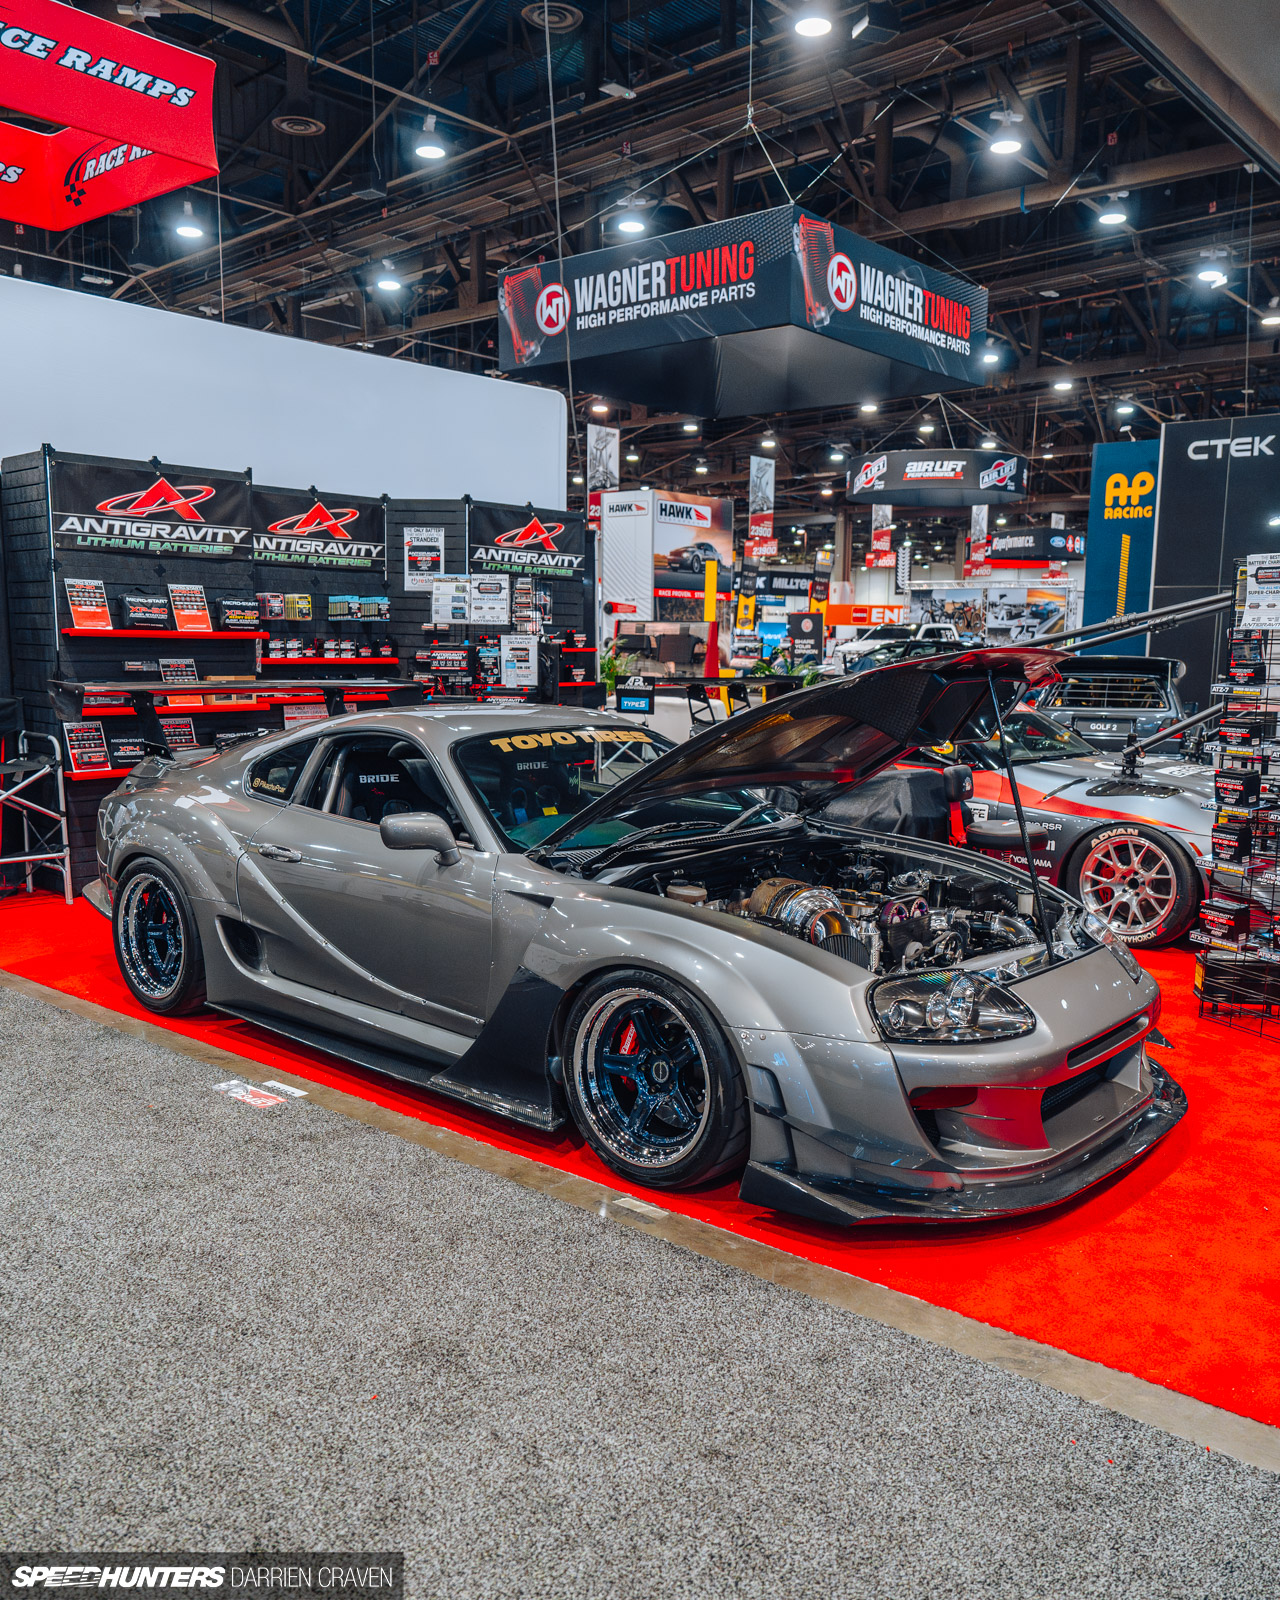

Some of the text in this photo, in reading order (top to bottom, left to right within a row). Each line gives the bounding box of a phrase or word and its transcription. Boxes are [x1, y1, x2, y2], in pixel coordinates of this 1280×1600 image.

[56, 45, 197, 107] RAMPS
[82, 143, 129, 182] RACE
[576, 281, 756, 330] HIGH PERFORMANCE PARTS
[860, 303, 971, 356] HIGH PERFORMANCE PARTS
[1187, 434, 1277, 461] CTEK
[867, 459, 886, 477] LIFT
[982, 473, 999, 485] AIR
[999, 463, 1015, 477] LIFT
[1104, 471, 1155, 507] AP
[609, 503, 633, 513] HAWK
[659, 503, 693, 520] HAWK
[1104, 505, 1153, 520] RACING
[58, 516, 249, 544] ANTIGRAVITY
[750, 526, 772, 538] 23900
[77, 535, 234, 555] LITHIUM BATTERIES
[752, 546, 777, 556] 23900
[254, 551, 372, 567] LITHIUM BATTERIES
[472, 547, 584, 568] ANTIGRAVITY
[482, 562, 574, 577] LITHIUM BATTERIES
[129, 606, 168, 614] XP-20
[1090, 723, 1111, 731] GOLF
[489, 730, 653, 752] TOYO TIRES
[516, 761, 549, 770] BRIDE
[359, 773, 400, 783] BRIDE
[1042, 822, 1063, 831] RSR
[1090, 827, 1139, 848] ADVAN
